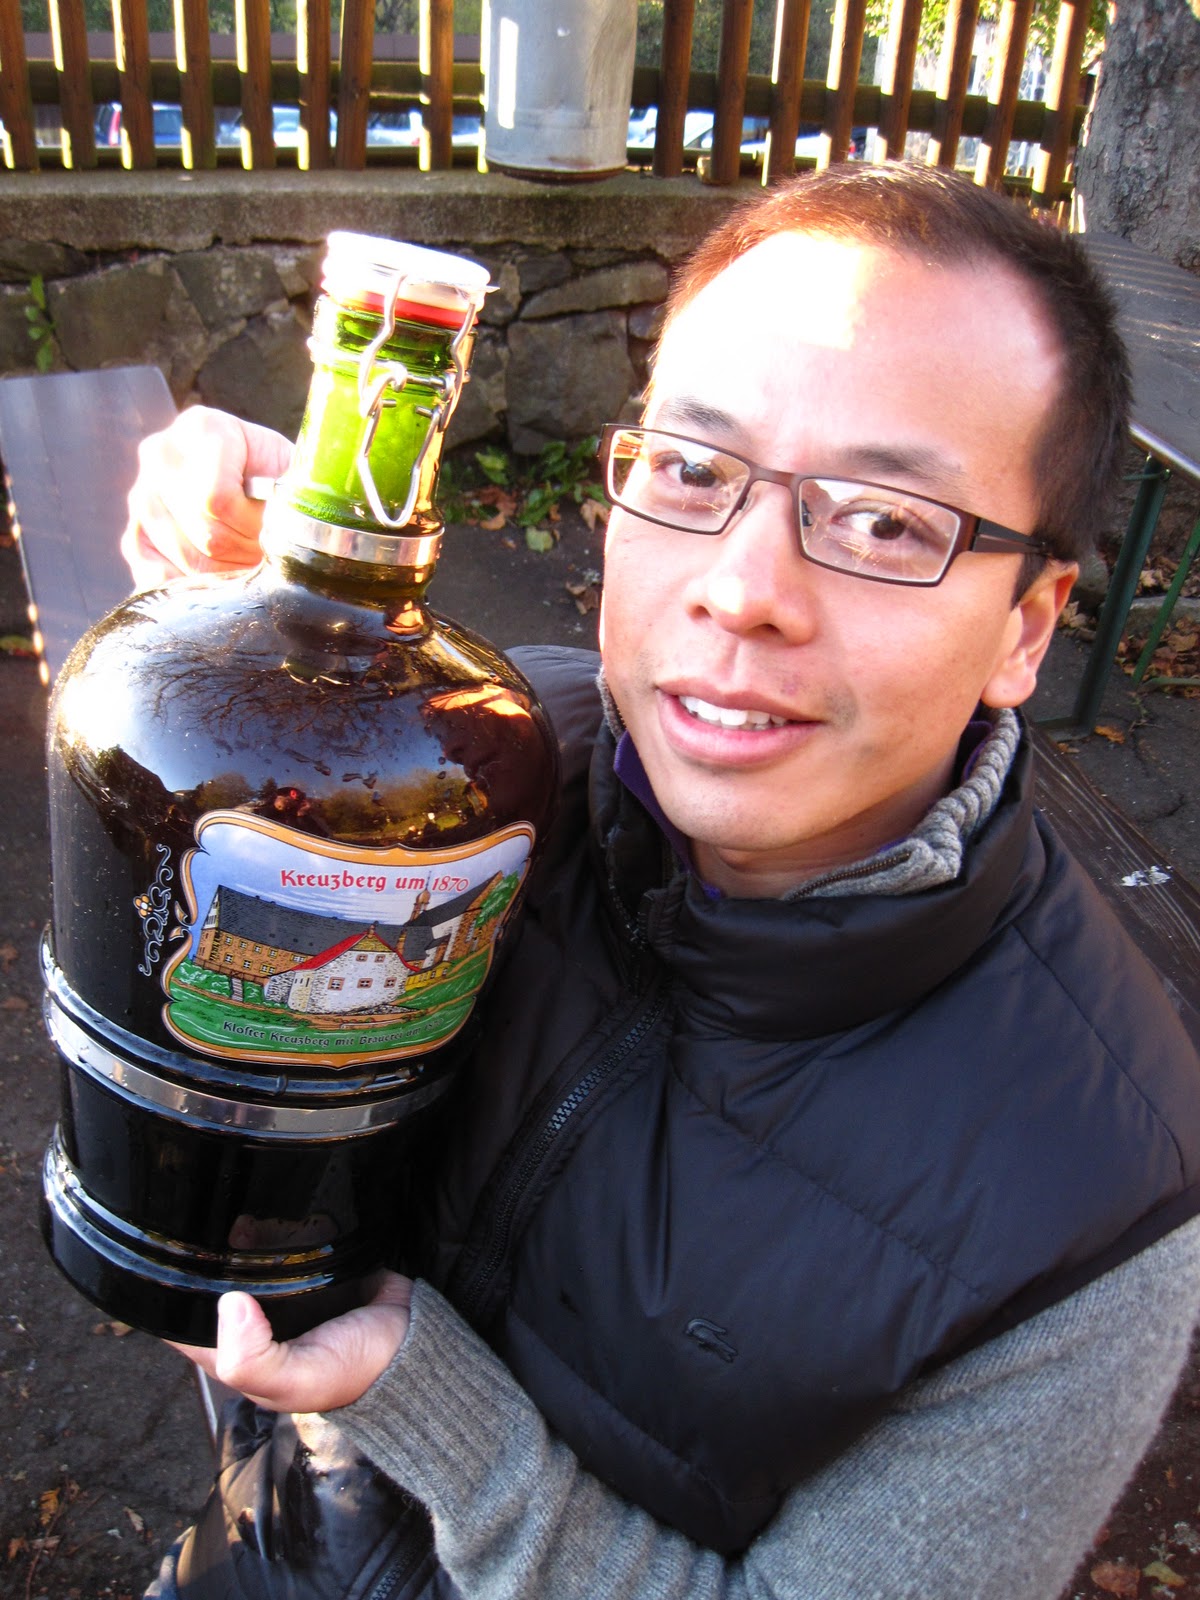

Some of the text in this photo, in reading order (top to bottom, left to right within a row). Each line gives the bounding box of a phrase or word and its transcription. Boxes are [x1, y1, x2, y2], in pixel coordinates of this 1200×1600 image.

[281, 869, 469, 892] Kreuzberg um 1870
[270, 1031, 330, 1047] Kreuzberg
[335, 1037, 354, 1046] mit
[359, 1033, 404, 1046] Brauerei
